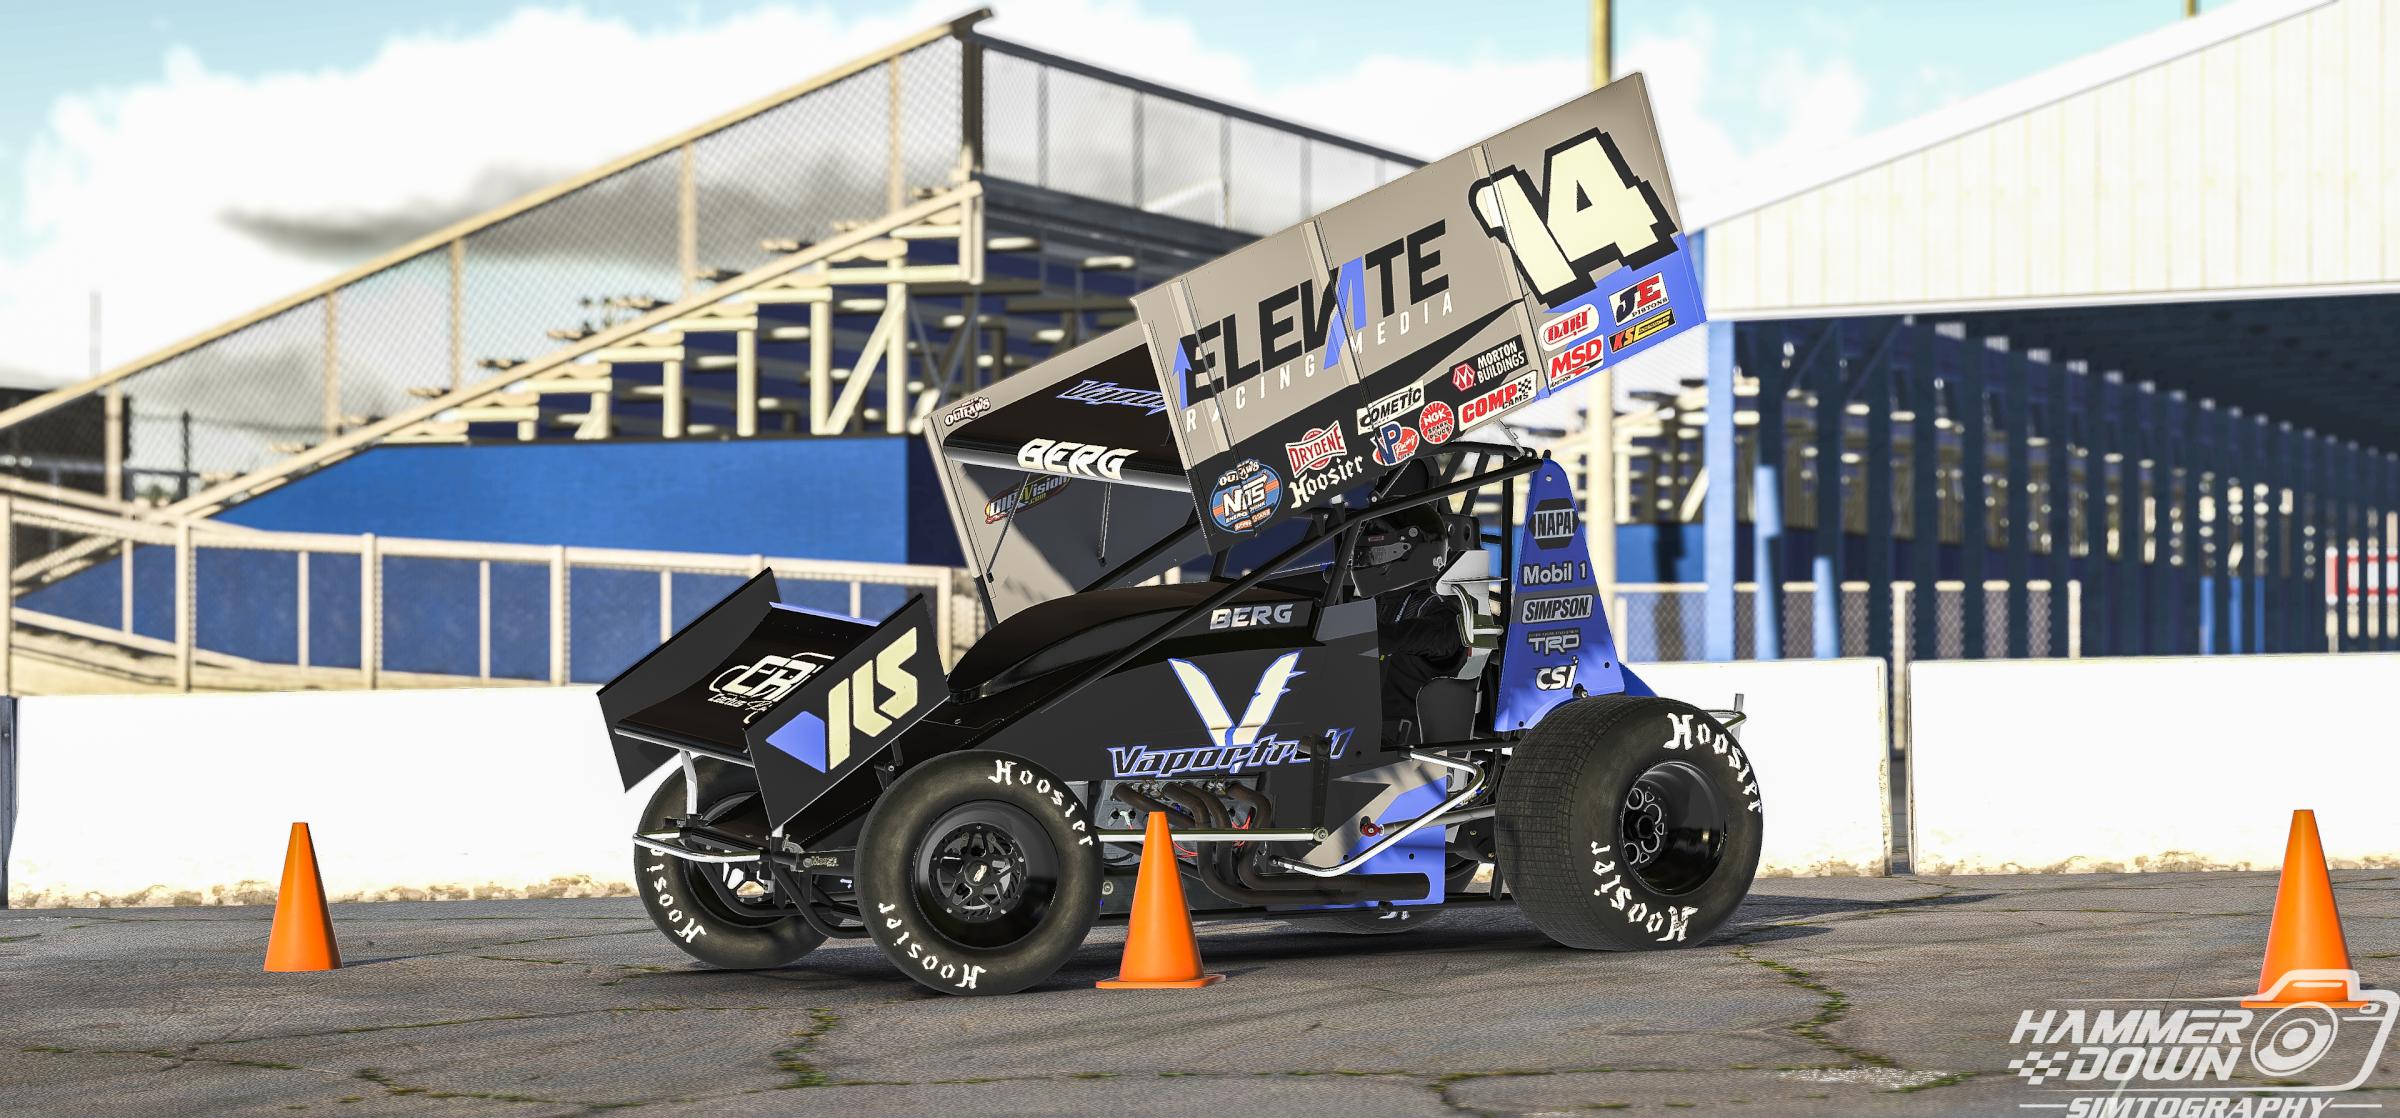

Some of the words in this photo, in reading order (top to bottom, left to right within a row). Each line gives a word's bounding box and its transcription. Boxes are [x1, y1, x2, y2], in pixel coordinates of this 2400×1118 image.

[1471, 128, 1679, 308] 14
[1180, 218, 1450, 407] ELEVATE
[1616, 275, 1661, 323] JE
[1631, 297, 1668, 317] PISTONS
[1350, 293, 1453, 355] MEDIA
[1477, 340, 1518, 369] MORTON
[1477, 351, 1525, 384] BUILDINGS
[1551, 339, 1603, 378] MSD
[944, 397, 991, 427] OUTLAWS
[1423, 408, 1447, 426] NGK
[1462, 383, 1518, 424] COMP
[1502, 392, 1529, 409] CAMS
[1372, 422, 1402, 465] VP
[1427, 421, 1449, 433] SPARK
[1017, 438, 1139, 480] BERG
[1288, 425, 1345, 473] DRYDENE
[1288, 455, 1364, 509] Hoosier
[1535, 511, 1573, 538] NAPA
[1523, 562, 1572, 585] Mobil
[1579, 562, 1587, 579] 1
[1210, 603, 1294, 630] BERG
[1525, 596, 1589, 622] SIMPSON
[1528, 634, 1580, 655] TRD
[1107, 727, 1355, 778] Vaportrl
[1662, 712, 1762, 813] Hoosier
[988, 759, 1094, 847] Hoosier
[646, 848, 707, 944] Hoosi
[1590, 840, 1699, 942] Hoosier
[878, 902, 987, 990] Hoosier
